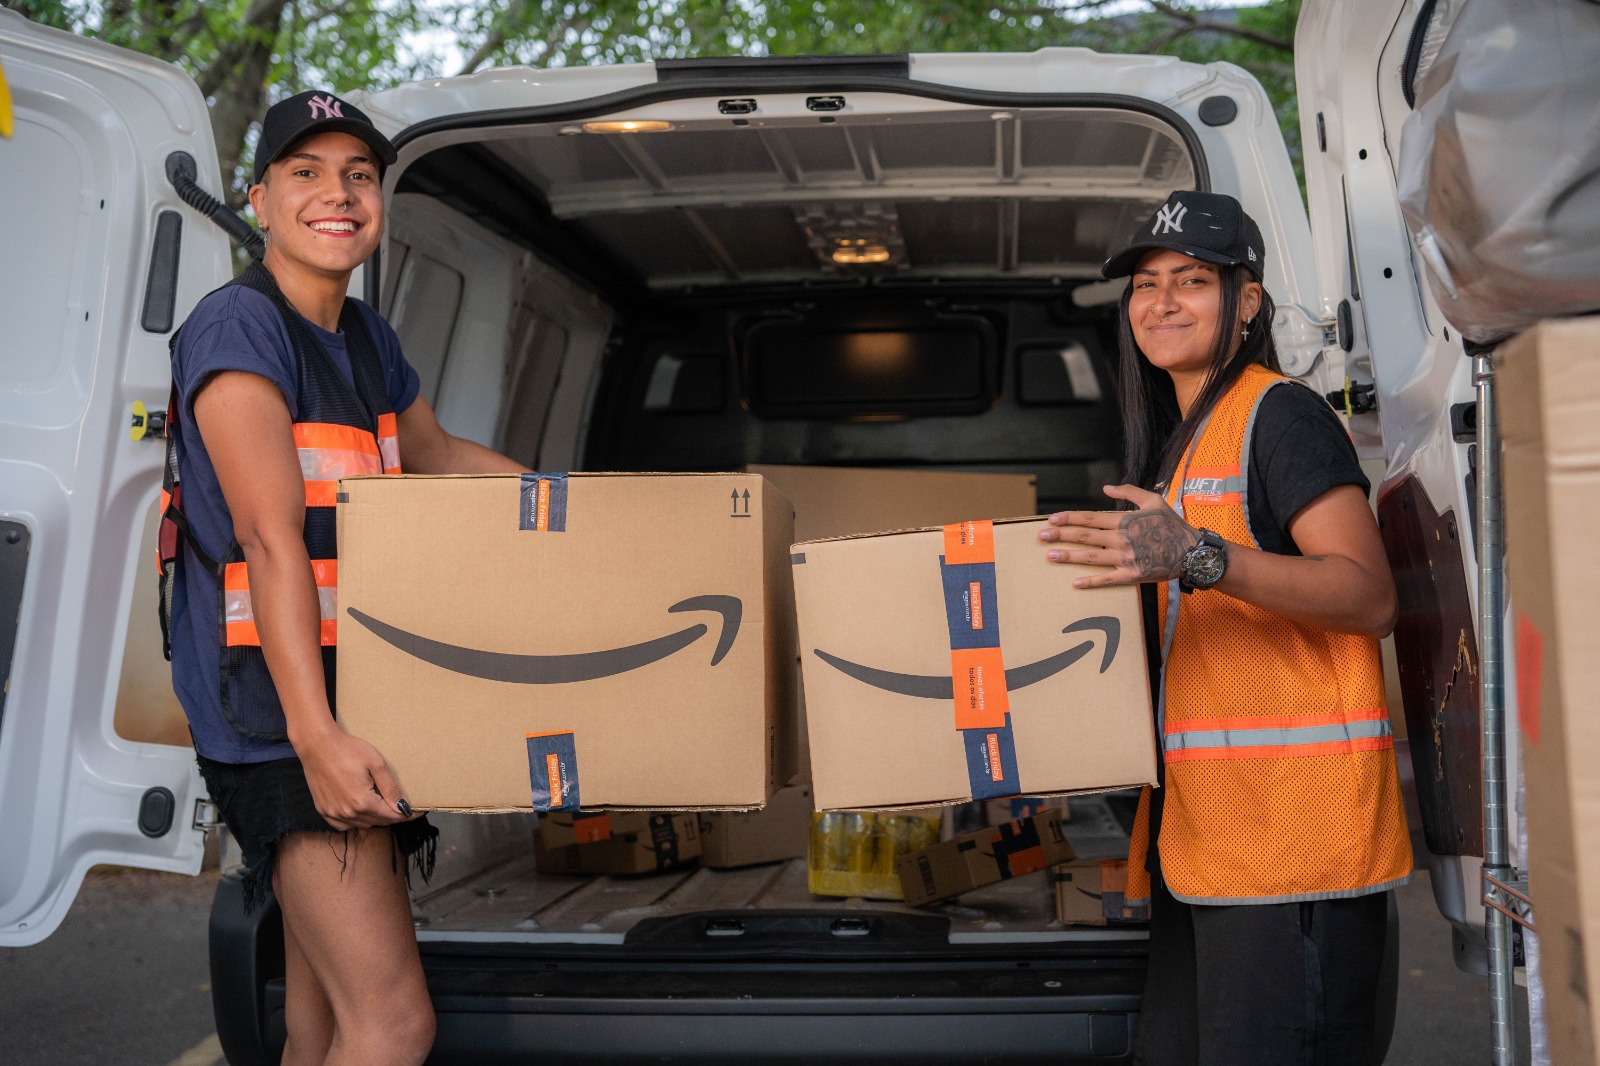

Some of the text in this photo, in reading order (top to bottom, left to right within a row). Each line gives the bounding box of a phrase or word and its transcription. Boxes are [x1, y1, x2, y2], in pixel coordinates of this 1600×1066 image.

[307, 95, 344, 119] NY
[1151, 201, 1188, 236] NY
[1184, 477, 1224, 490] LUFT
[537, 505, 547, 528] Friday
[990, 737, 1001, 779] Black Friday
[549, 757, 560, 803] Black Friday
